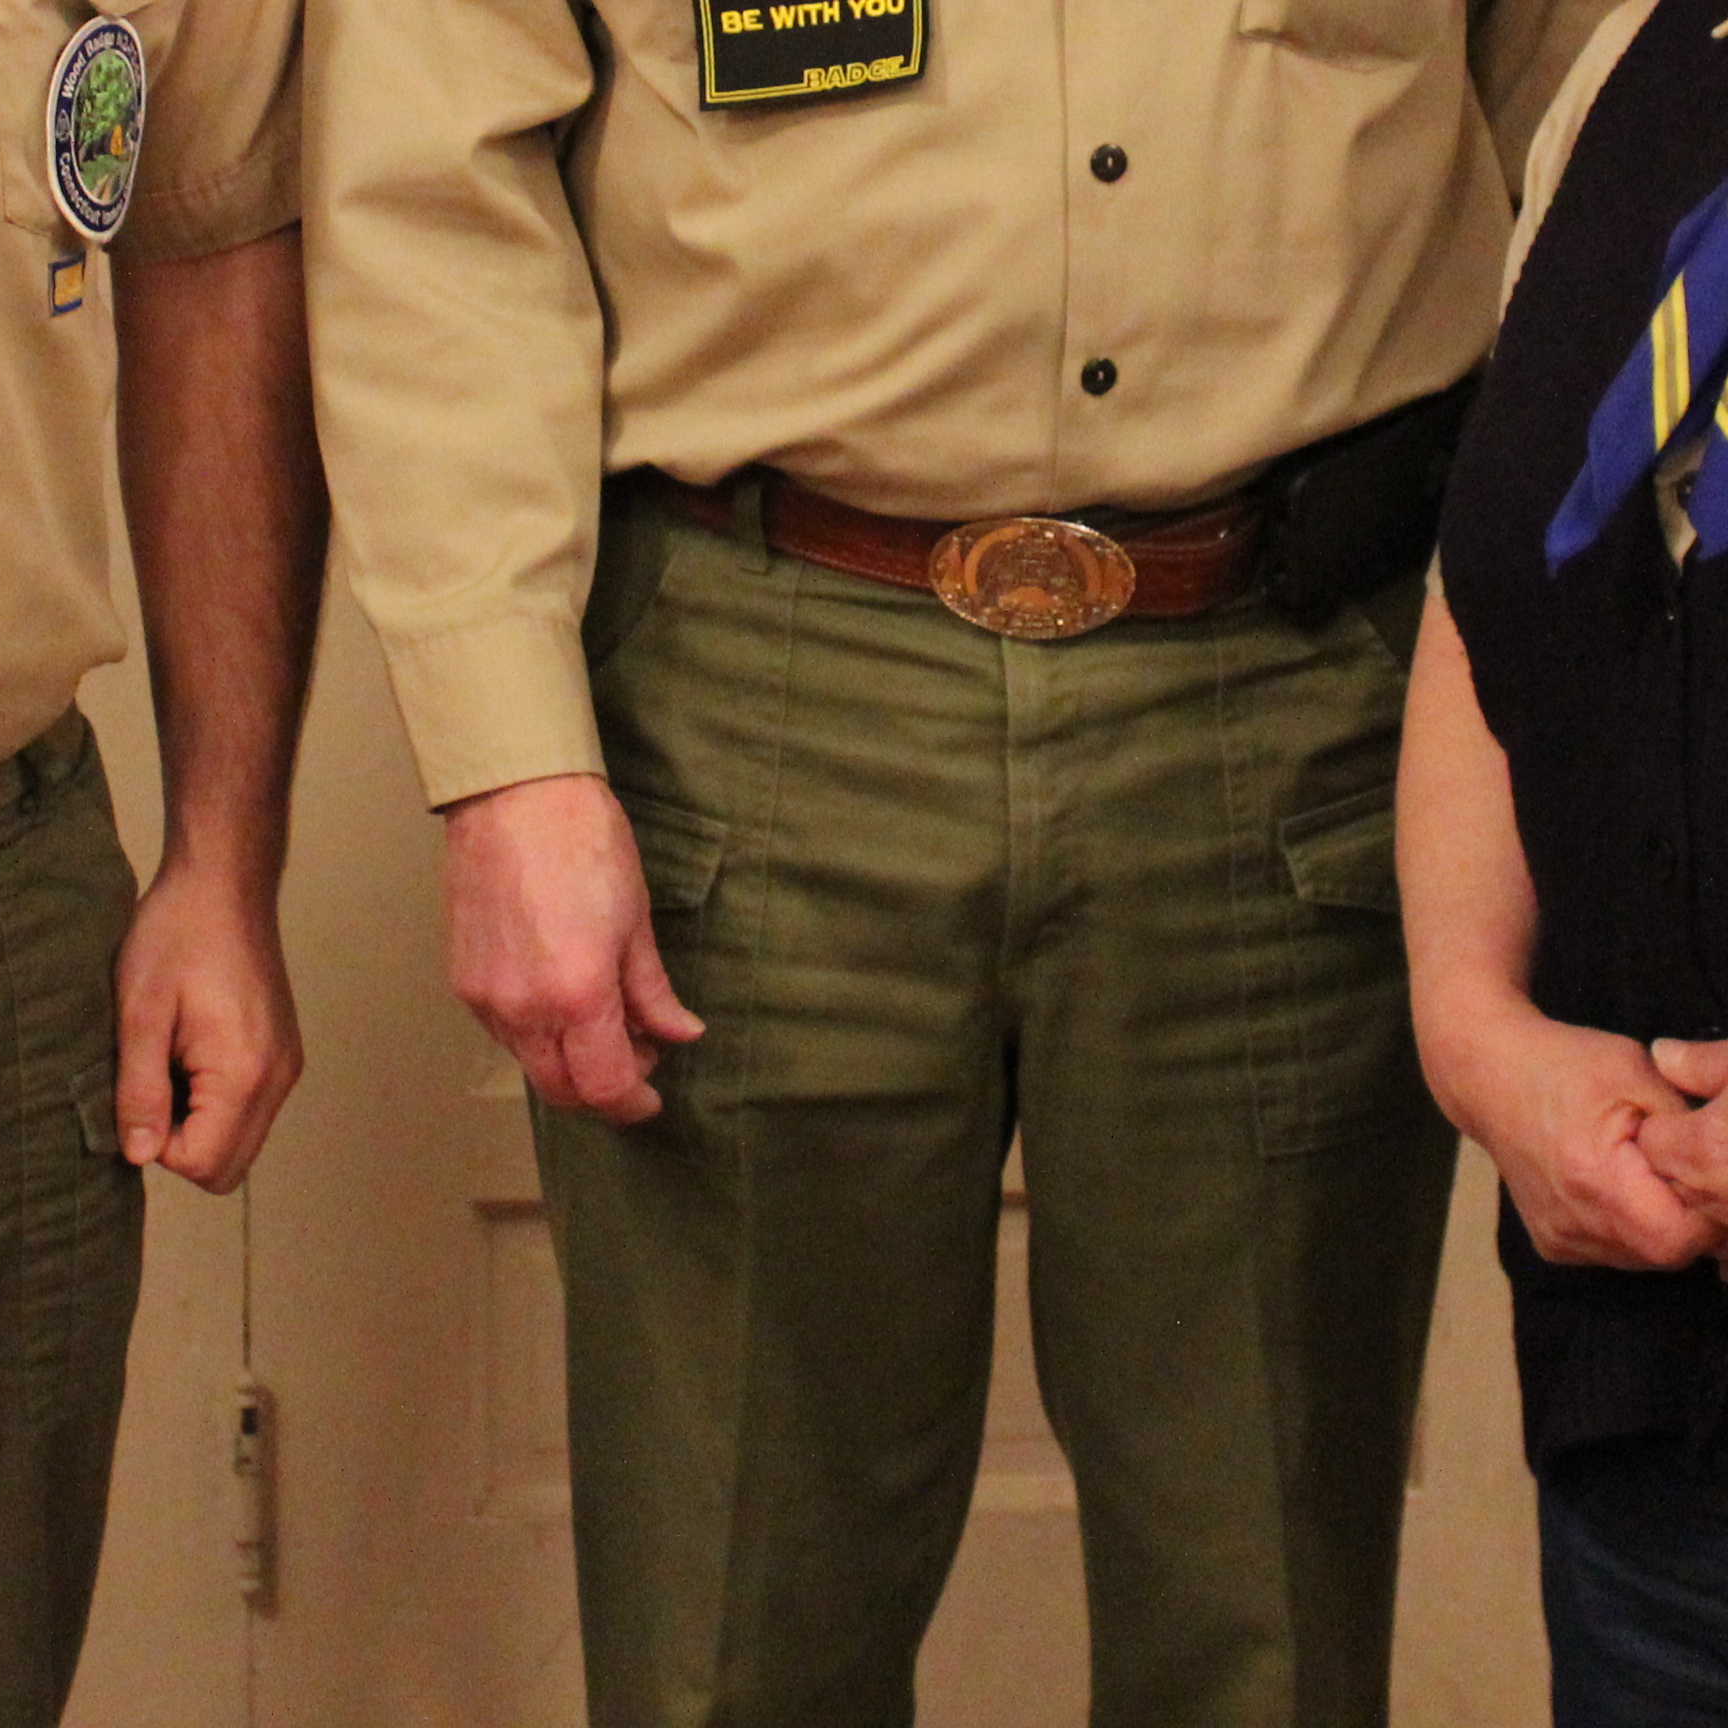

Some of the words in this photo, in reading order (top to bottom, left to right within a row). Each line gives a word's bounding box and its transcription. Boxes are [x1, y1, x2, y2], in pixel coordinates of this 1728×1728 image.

[720, 8, 764, 34] BE
[769, 0, 841, 30] WITH
[60, 50, 87, 100] Wood
[803, 54, 905, 90] BADGE
